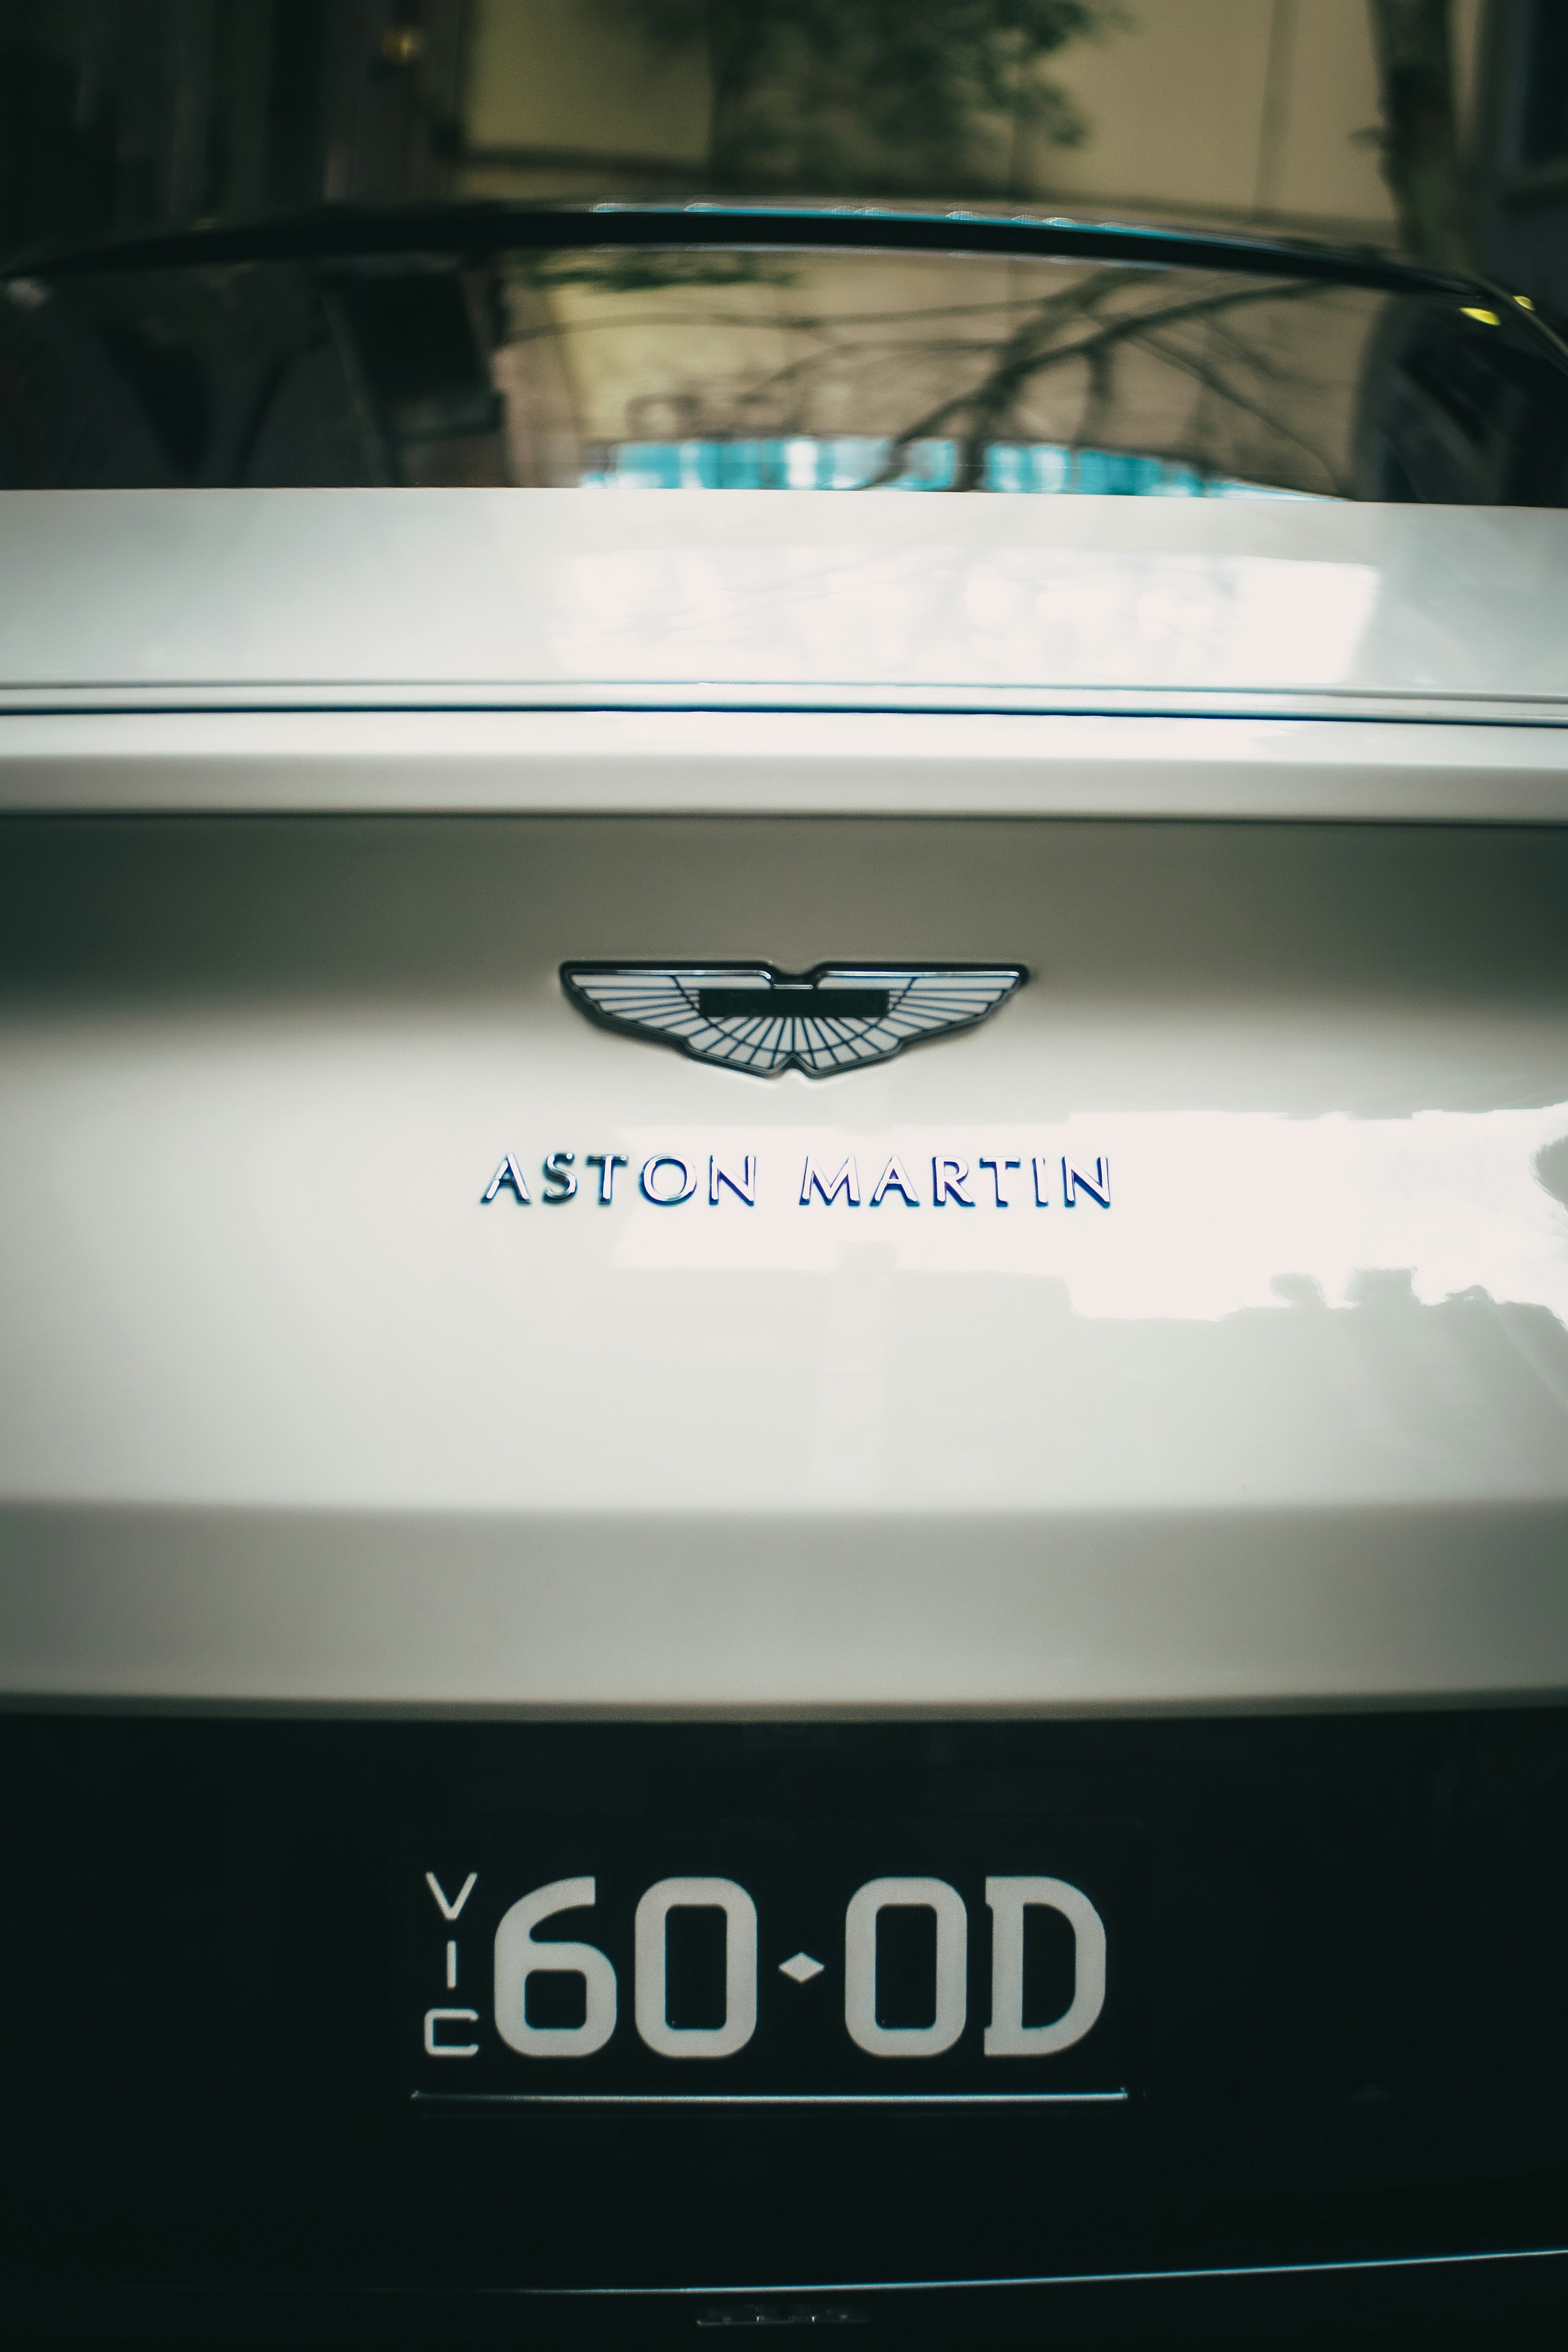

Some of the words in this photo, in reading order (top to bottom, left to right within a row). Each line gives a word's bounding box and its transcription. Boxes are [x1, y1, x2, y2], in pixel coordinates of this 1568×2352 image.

[480, 1153, 756, 1207] ASTON
[799, 1156, 1111, 1209] MARTIN
[424, 1872, 479, 2056] VIC
